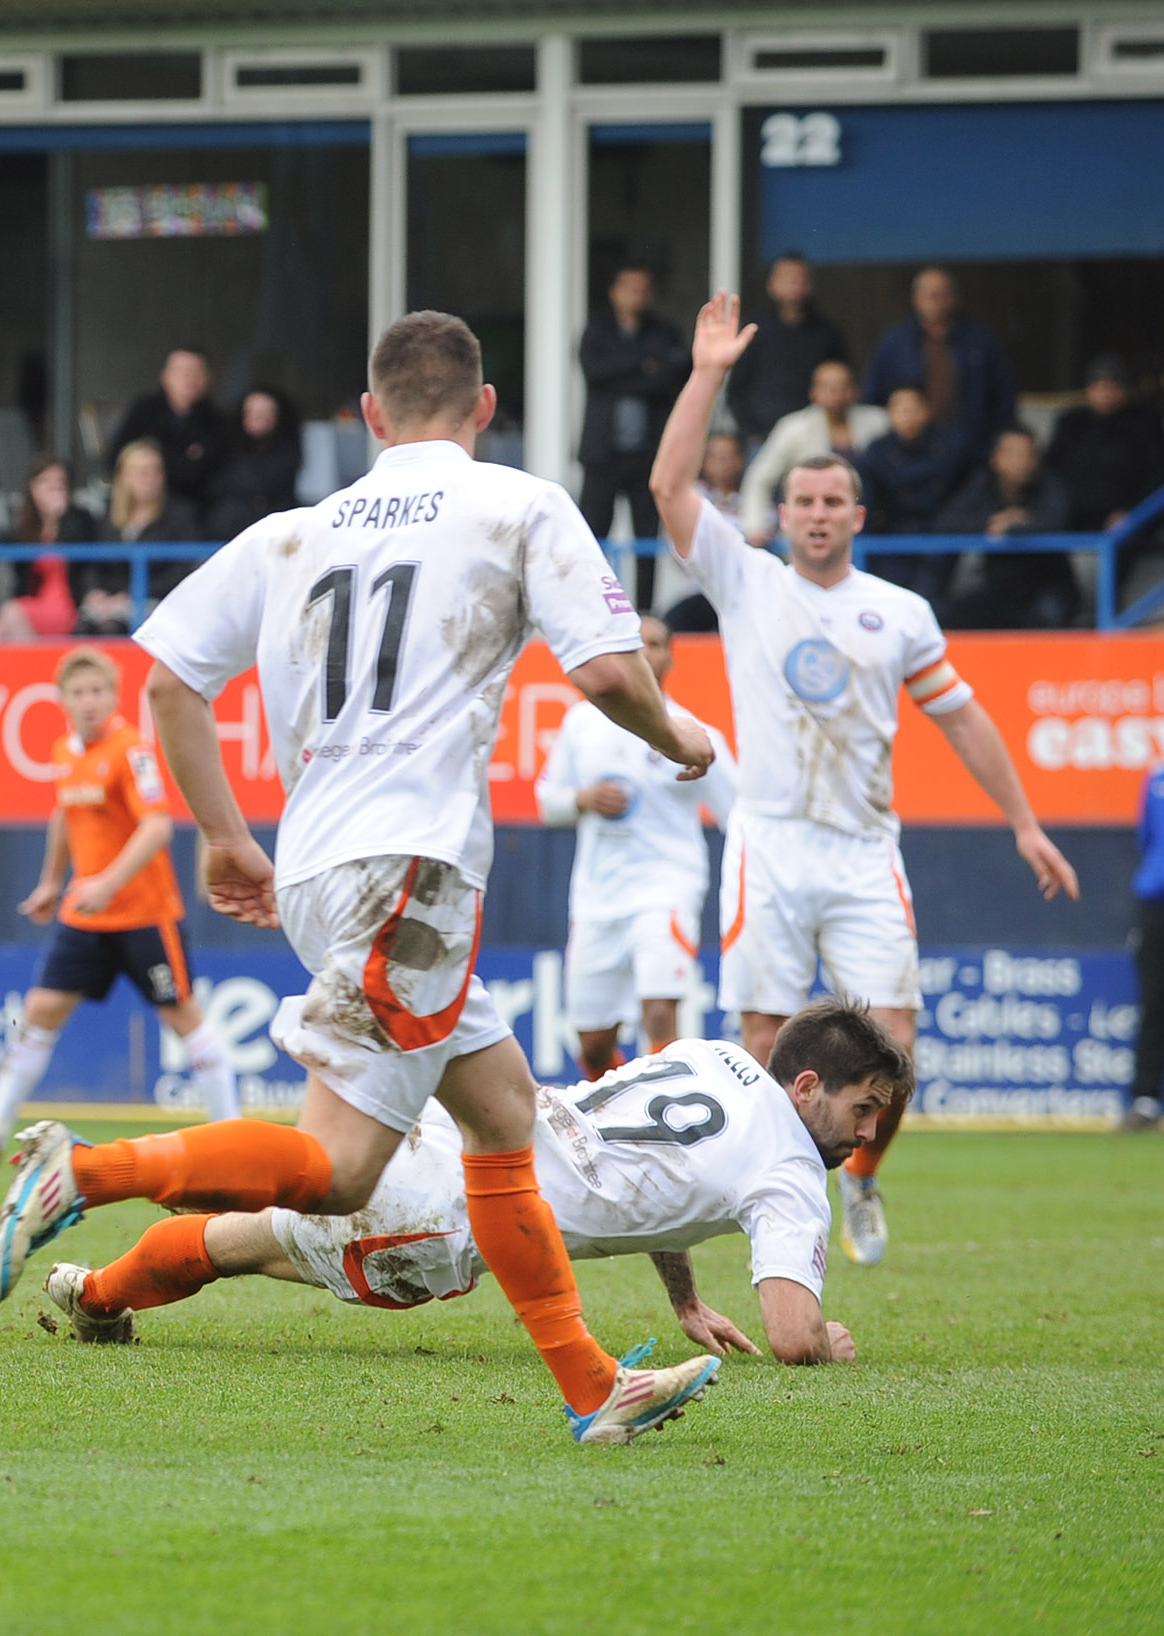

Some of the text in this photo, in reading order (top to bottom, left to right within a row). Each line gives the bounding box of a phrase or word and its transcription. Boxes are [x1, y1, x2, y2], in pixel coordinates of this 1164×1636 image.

[760, 112, 840, 166] 22
[332, 490, 444, 529] SPARKES
[305, 561, 422, 724] 11
[1027, 680, 1151, 717] europe
[984, 950, 1082, 996] Brass
[937, 992, 1062, 1040] Cables
[917, 1036, 1135, 1086] Stainless Ste
[574, 1061, 730, 1149] 19
